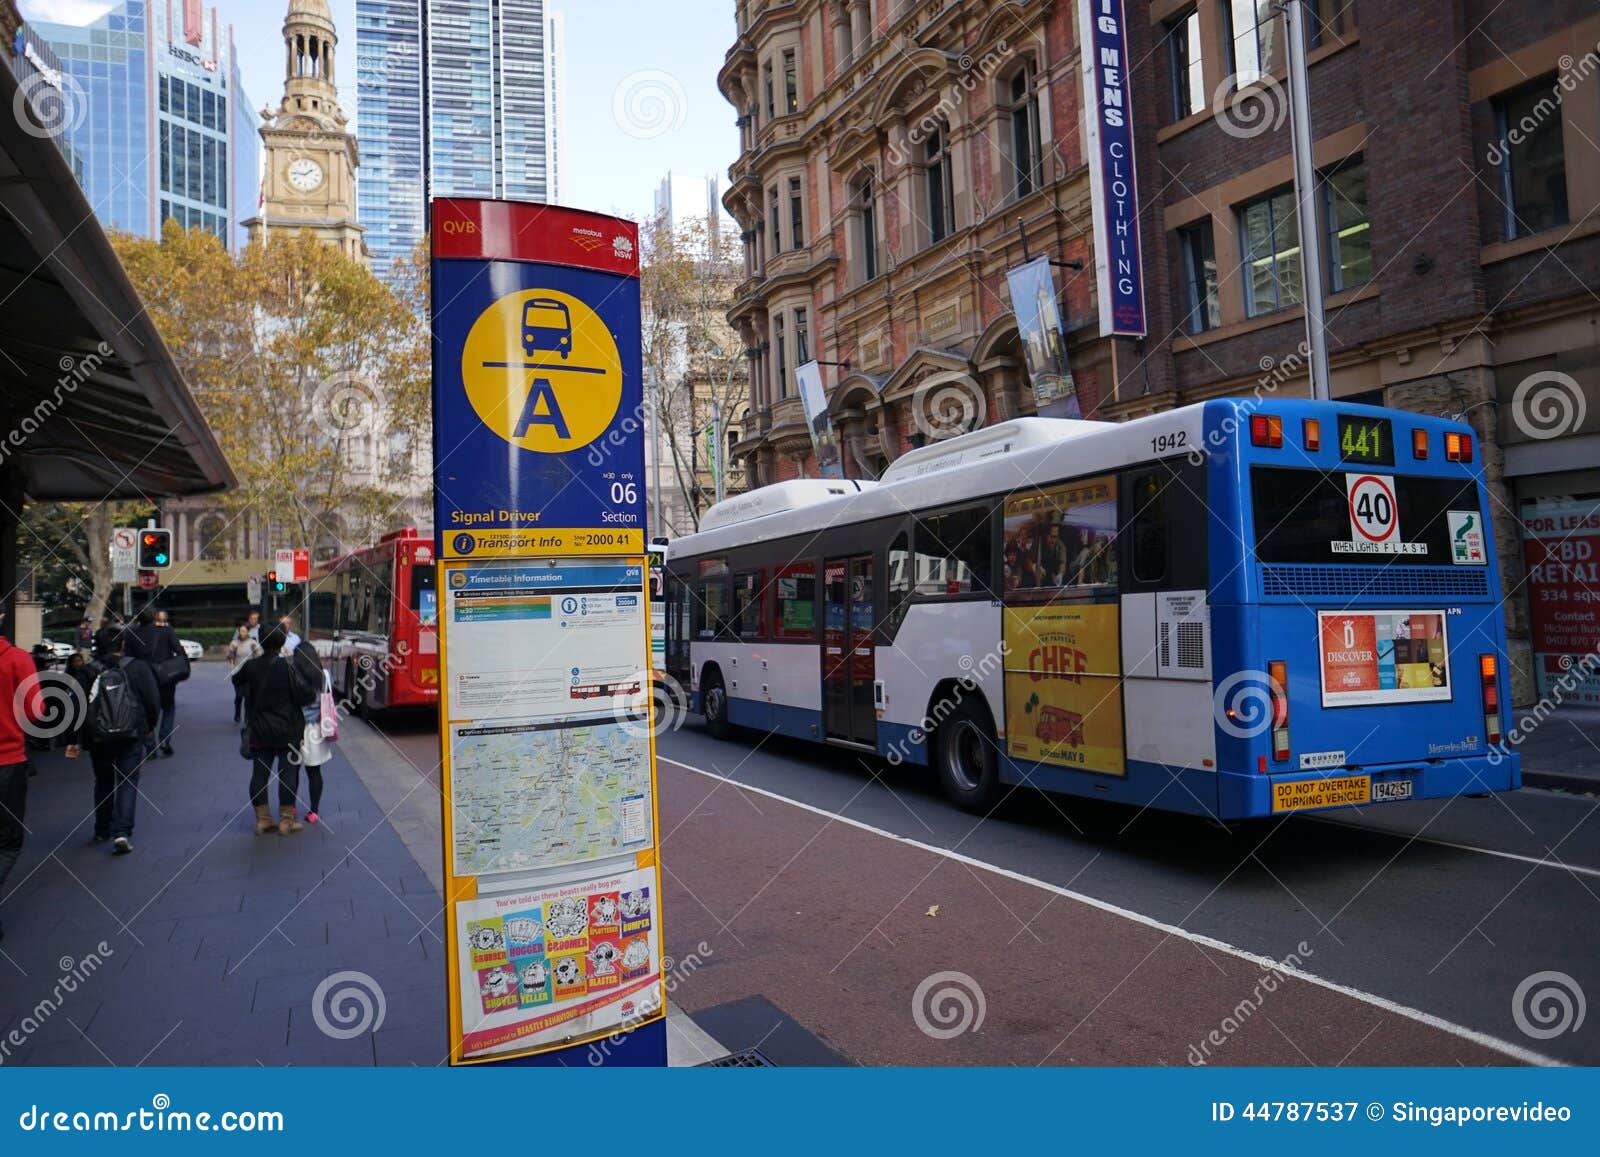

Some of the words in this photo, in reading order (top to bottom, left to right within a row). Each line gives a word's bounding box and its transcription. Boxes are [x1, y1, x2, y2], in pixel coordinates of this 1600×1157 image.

[1098, 0, 1118, 35] IG
[169, 42, 200, 66] HSBC
[1100, 47, 1124, 127] MENS
[1109, 141, 1133, 296] CLOTHING
[442, 220, 476, 235] QVB
[572, 227, 603, 238] metrobus
[614, 249, 632, 260] NSW
[511, 378, 572, 439] A
[1149, 431, 1188, 454] 1942
[1342, 424, 1381, 457] 441
[621, 472, 634, 481] only
[611, 481, 637, 505] 06
[1356, 493, 1391, 525] 40
[451, 510, 494, 525] Signal
[498, 509, 541, 522] Driver
[601, 511, 637, 523] Section
[1524, 518, 1555, 532] FOR
[477, 537, 535, 551] Transport
[539, 535, 563, 547] Info
[586, 534, 614, 546] 2000
[617, 534, 630, 545] 41
[1333, 542, 1354, 552] WHEN
[1355, 542, 1380, 552] LIGHTS
[1546, 540, 1593, 562] CBD
[470, 575, 512, 584] Timetable
[514, 572, 563, 582] Information
[626, 569, 640, 577] QVB
[1540, 589, 1568, 601] 334
[1447, 607, 1462, 615] APN
[1554, 611, 1595, 622] Contact
[1327, 650, 1374, 663] DISCOVER
[1028, 645, 1089, 685] CHEF
[1428, 741, 1478, 754] Mercedes-Benz
[1060, 750, 1077, 762] MAY
[1278, 785, 1292, 796] DO
[1295, 783, 1316, 794] NOT
[1318, 778, 1367, 792] OVERTAKE
[1374, 783, 1396, 798] 1942
[1280, 795, 1322, 809] TURNING
[1326, 790, 1365, 803] VEHICLE
[496, 898, 518, 907] You've
[518, 895, 532, 904] told
[541, 891, 559, 901] these
[560, 887, 580, 898] beasts
[581, 883, 597, 895] really
[598, 880, 610, 890] bug
[546, 937, 588, 953] GROOMER
[520, 991, 548, 1003] YELLER
[516, 1020, 544, 1037] BEASTLY
[544, 1008, 578, 1028] BEHAVIOUR
